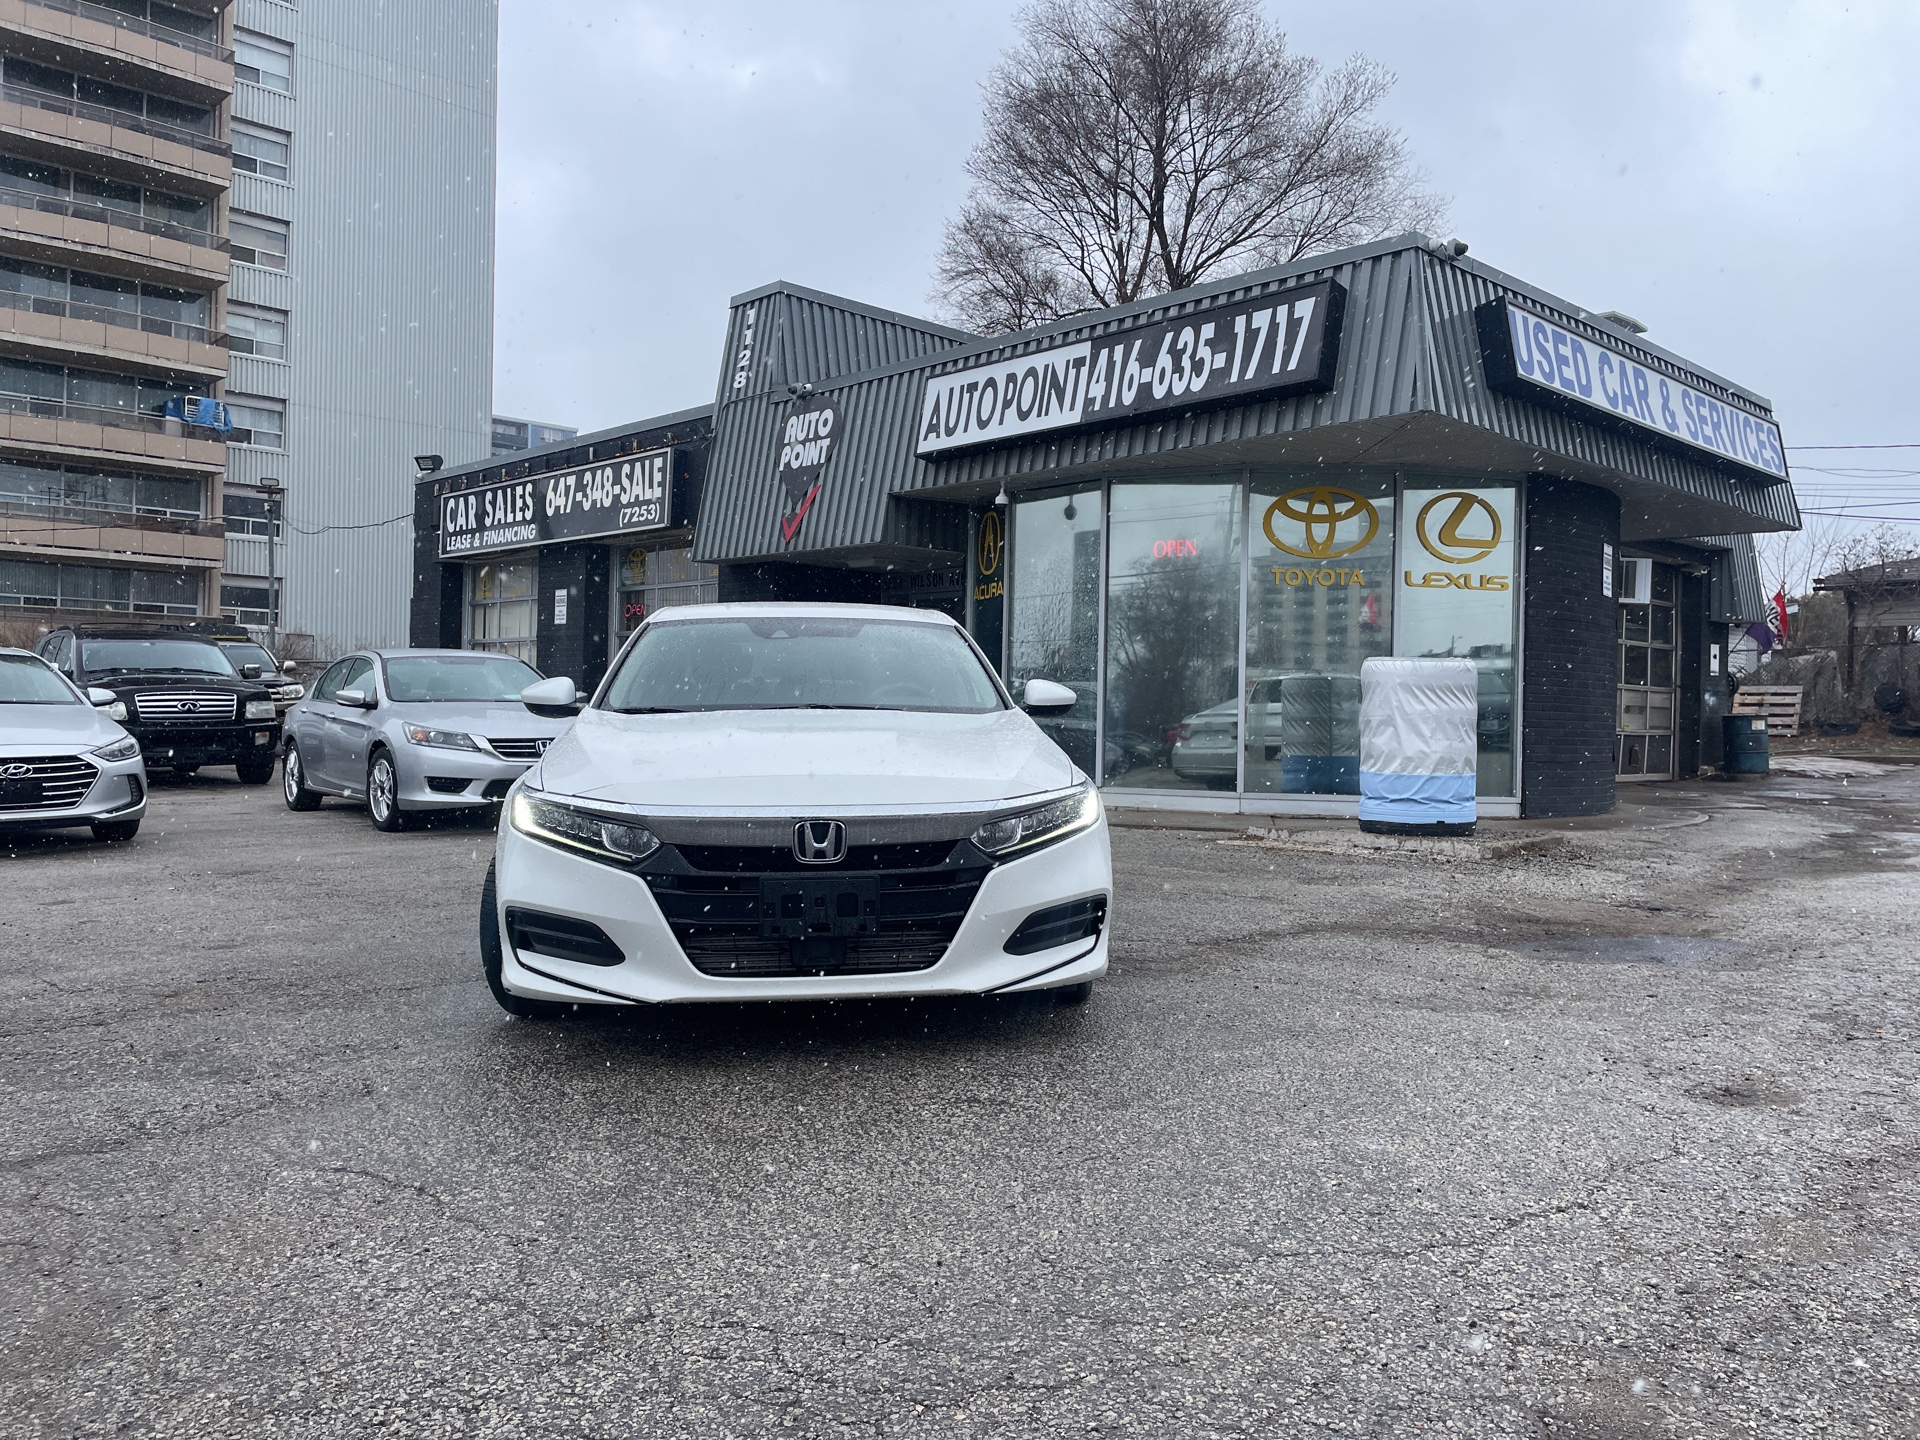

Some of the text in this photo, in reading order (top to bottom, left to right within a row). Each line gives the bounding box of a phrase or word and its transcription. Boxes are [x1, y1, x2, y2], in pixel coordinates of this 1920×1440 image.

[733, 308, 756, 389] 1128
[1088, 297, 1316, 411] 416-635-1717
[1509, 308, 1785, 474] USED CAR & SERVICES
[785, 408, 834, 442] AUTO
[780, 437, 831, 471] POINT
[446, 456, 663, 533] CAR SALES 647-348-SALE
[619, 502, 660, 527] (7253)
[446, 523, 536, 551] LEASE & FINANCING
[1153, 538, 1197, 559] OPEN
[910, 573, 944, 588] WILSON
[973, 580, 1004, 600] ACURA
[1270, 568, 1365, 587] TOYOTA
[1404, 570, 1510, 591] LEXUS
[624, 603, 645, 617] OPEN
